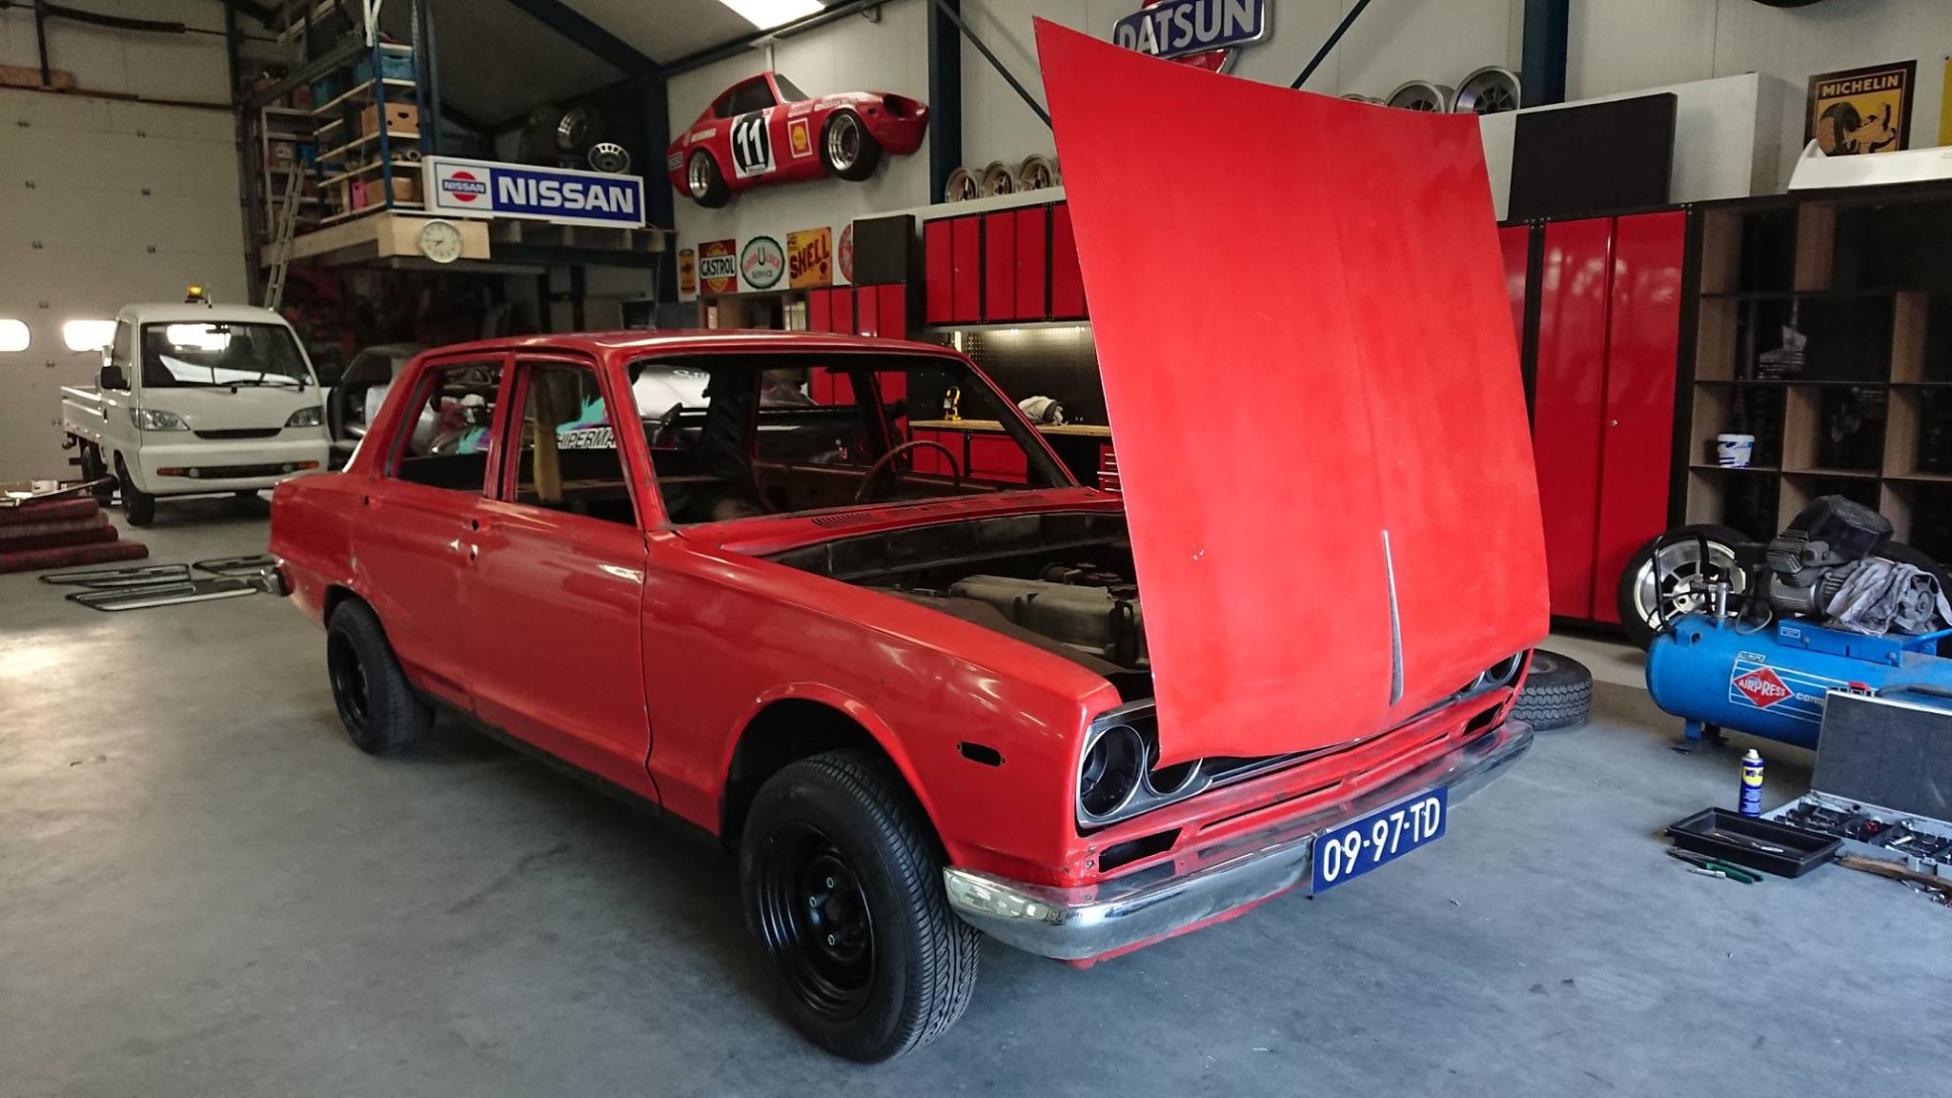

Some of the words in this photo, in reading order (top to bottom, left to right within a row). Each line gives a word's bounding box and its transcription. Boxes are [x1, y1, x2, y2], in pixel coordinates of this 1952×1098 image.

[1118, 0, 1255, 55] DATSUN
[1821, 74, 1899, 97] MICHELIN
[736, 118, 765, 166] 11
[443, 181, 485, 192] NISSAN
[498, 176, 634, 214] NISSAN
[701, 257, 736, 276] CASTROL
[789, 234, 830, 280] SHELL
[1738, 677, 1786, 697] AIRPRESS
[1323, 797, 1440, 882] 09-97-TD
